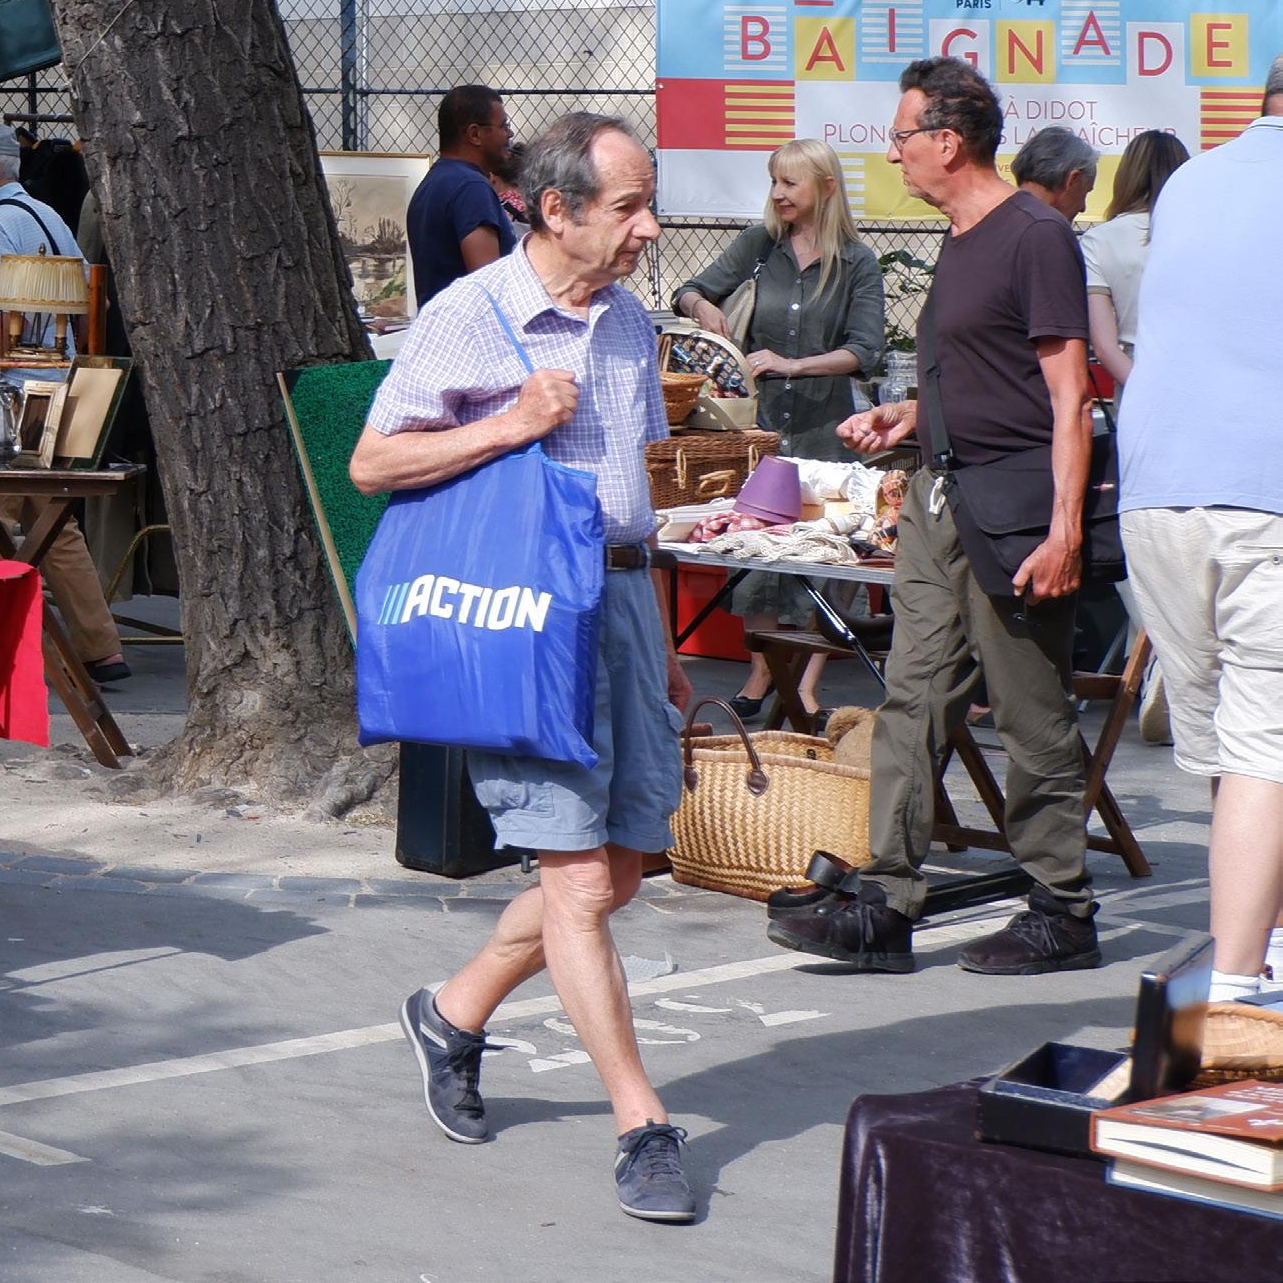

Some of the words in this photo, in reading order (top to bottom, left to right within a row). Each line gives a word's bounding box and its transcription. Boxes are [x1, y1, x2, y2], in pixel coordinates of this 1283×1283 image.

[739, 7, 1234, 76] BAIGNADE
[1004, 95, 1020, 120] À
[1026, 100, 1098, 121] DIDOT
[824, 123, 894, 144] PLON
[400, 574, 553, 632] ACTION
